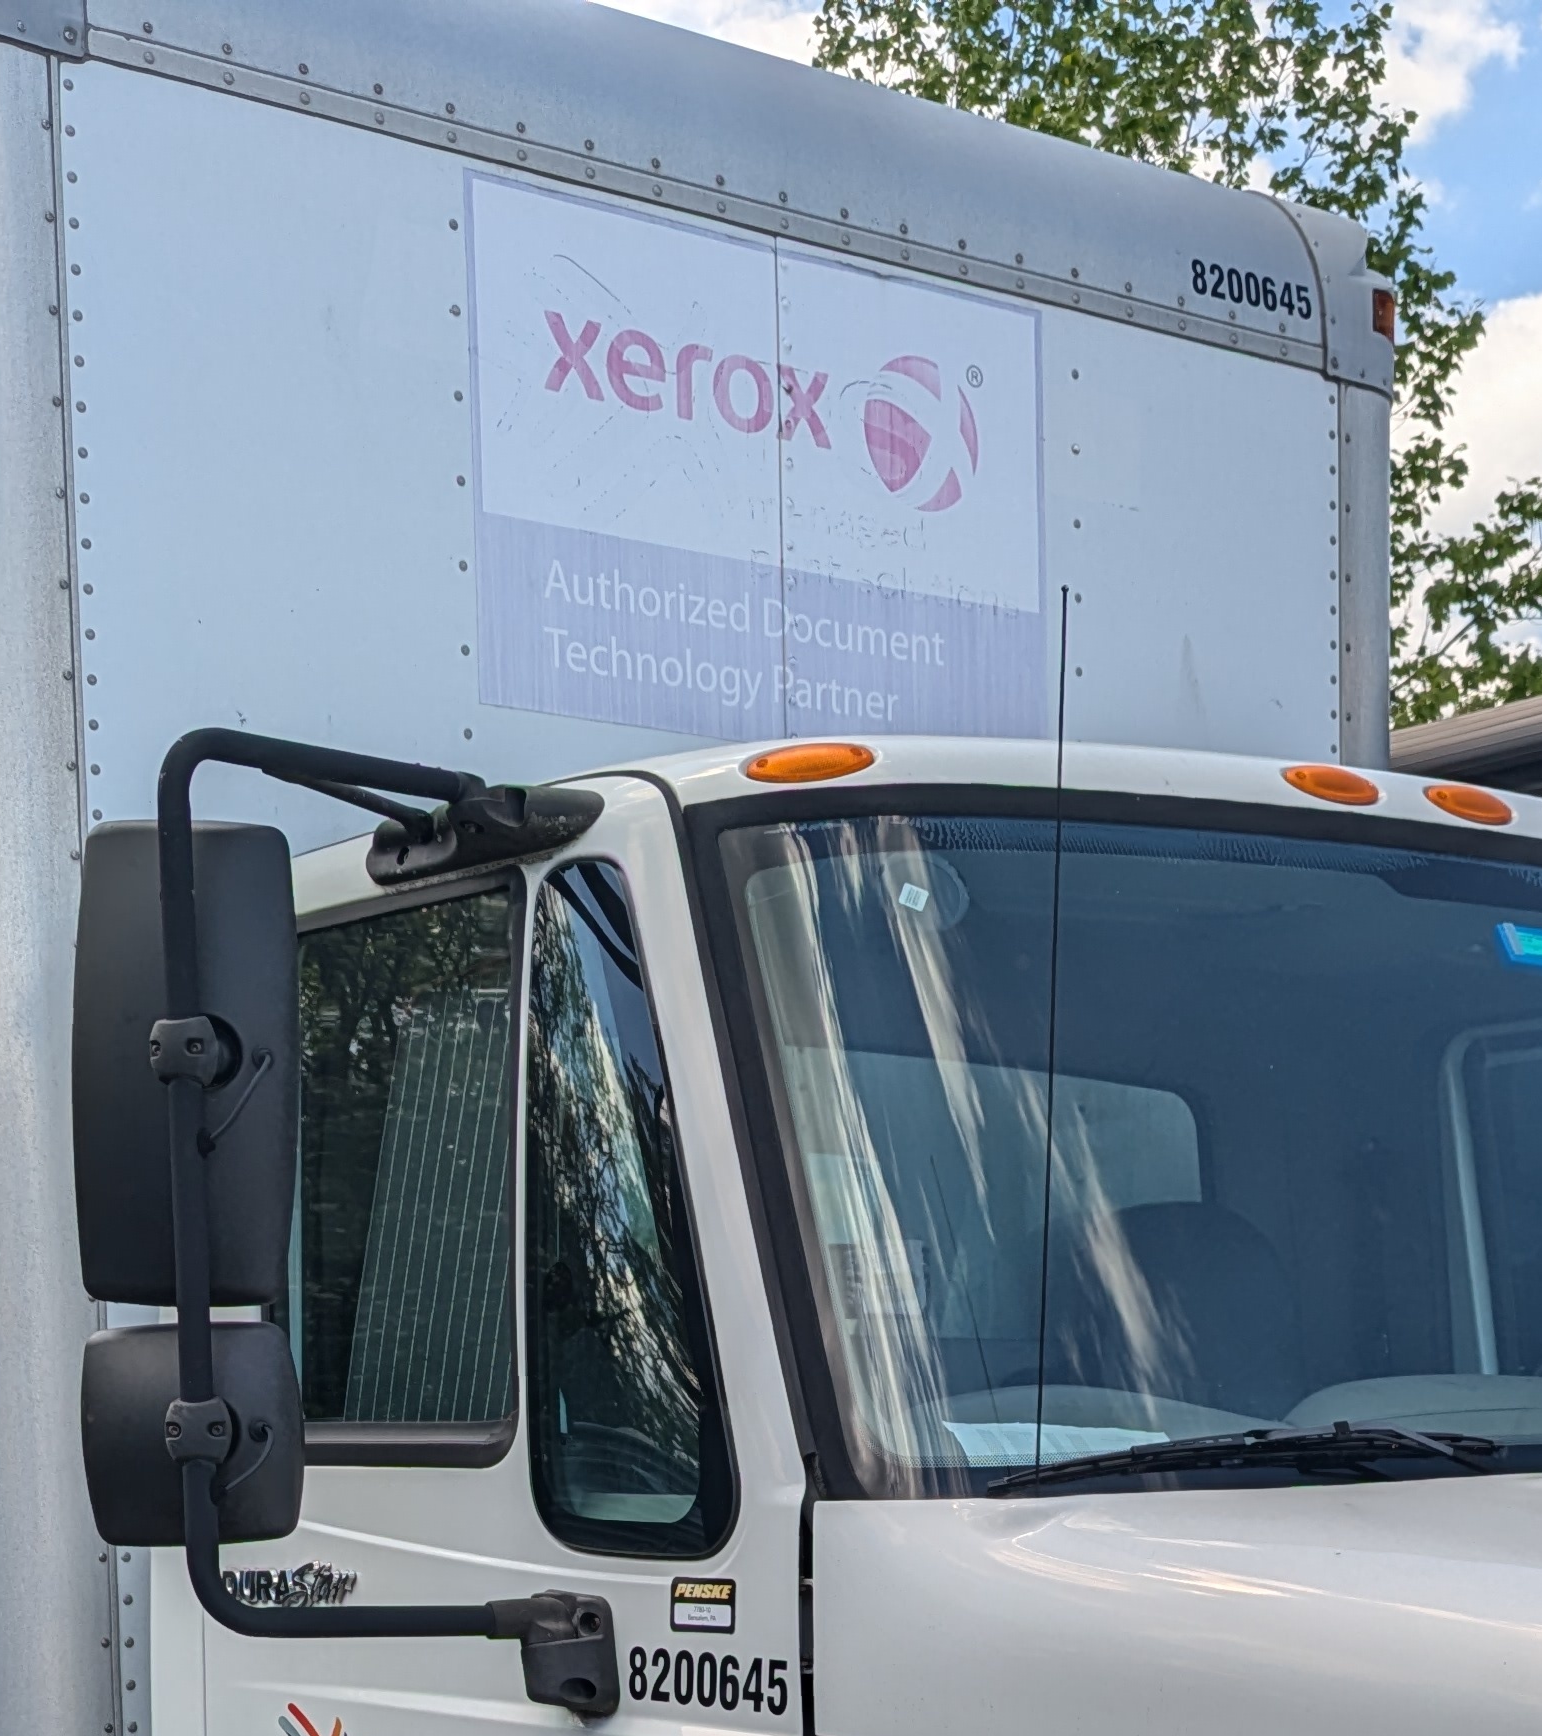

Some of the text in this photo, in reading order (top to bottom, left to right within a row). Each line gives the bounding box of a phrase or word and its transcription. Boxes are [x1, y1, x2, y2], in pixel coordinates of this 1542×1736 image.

[1190, 258, 1313, 320] 8200645
[543, 309, 832, 450] xerox
[542, 559, 946, 667] Authorized Document
[542, 626, 900, 721] Technology Partner
[674, 1583, 733, 1600] PENSKE
[627, 1645, 788, 1716] 8200645
